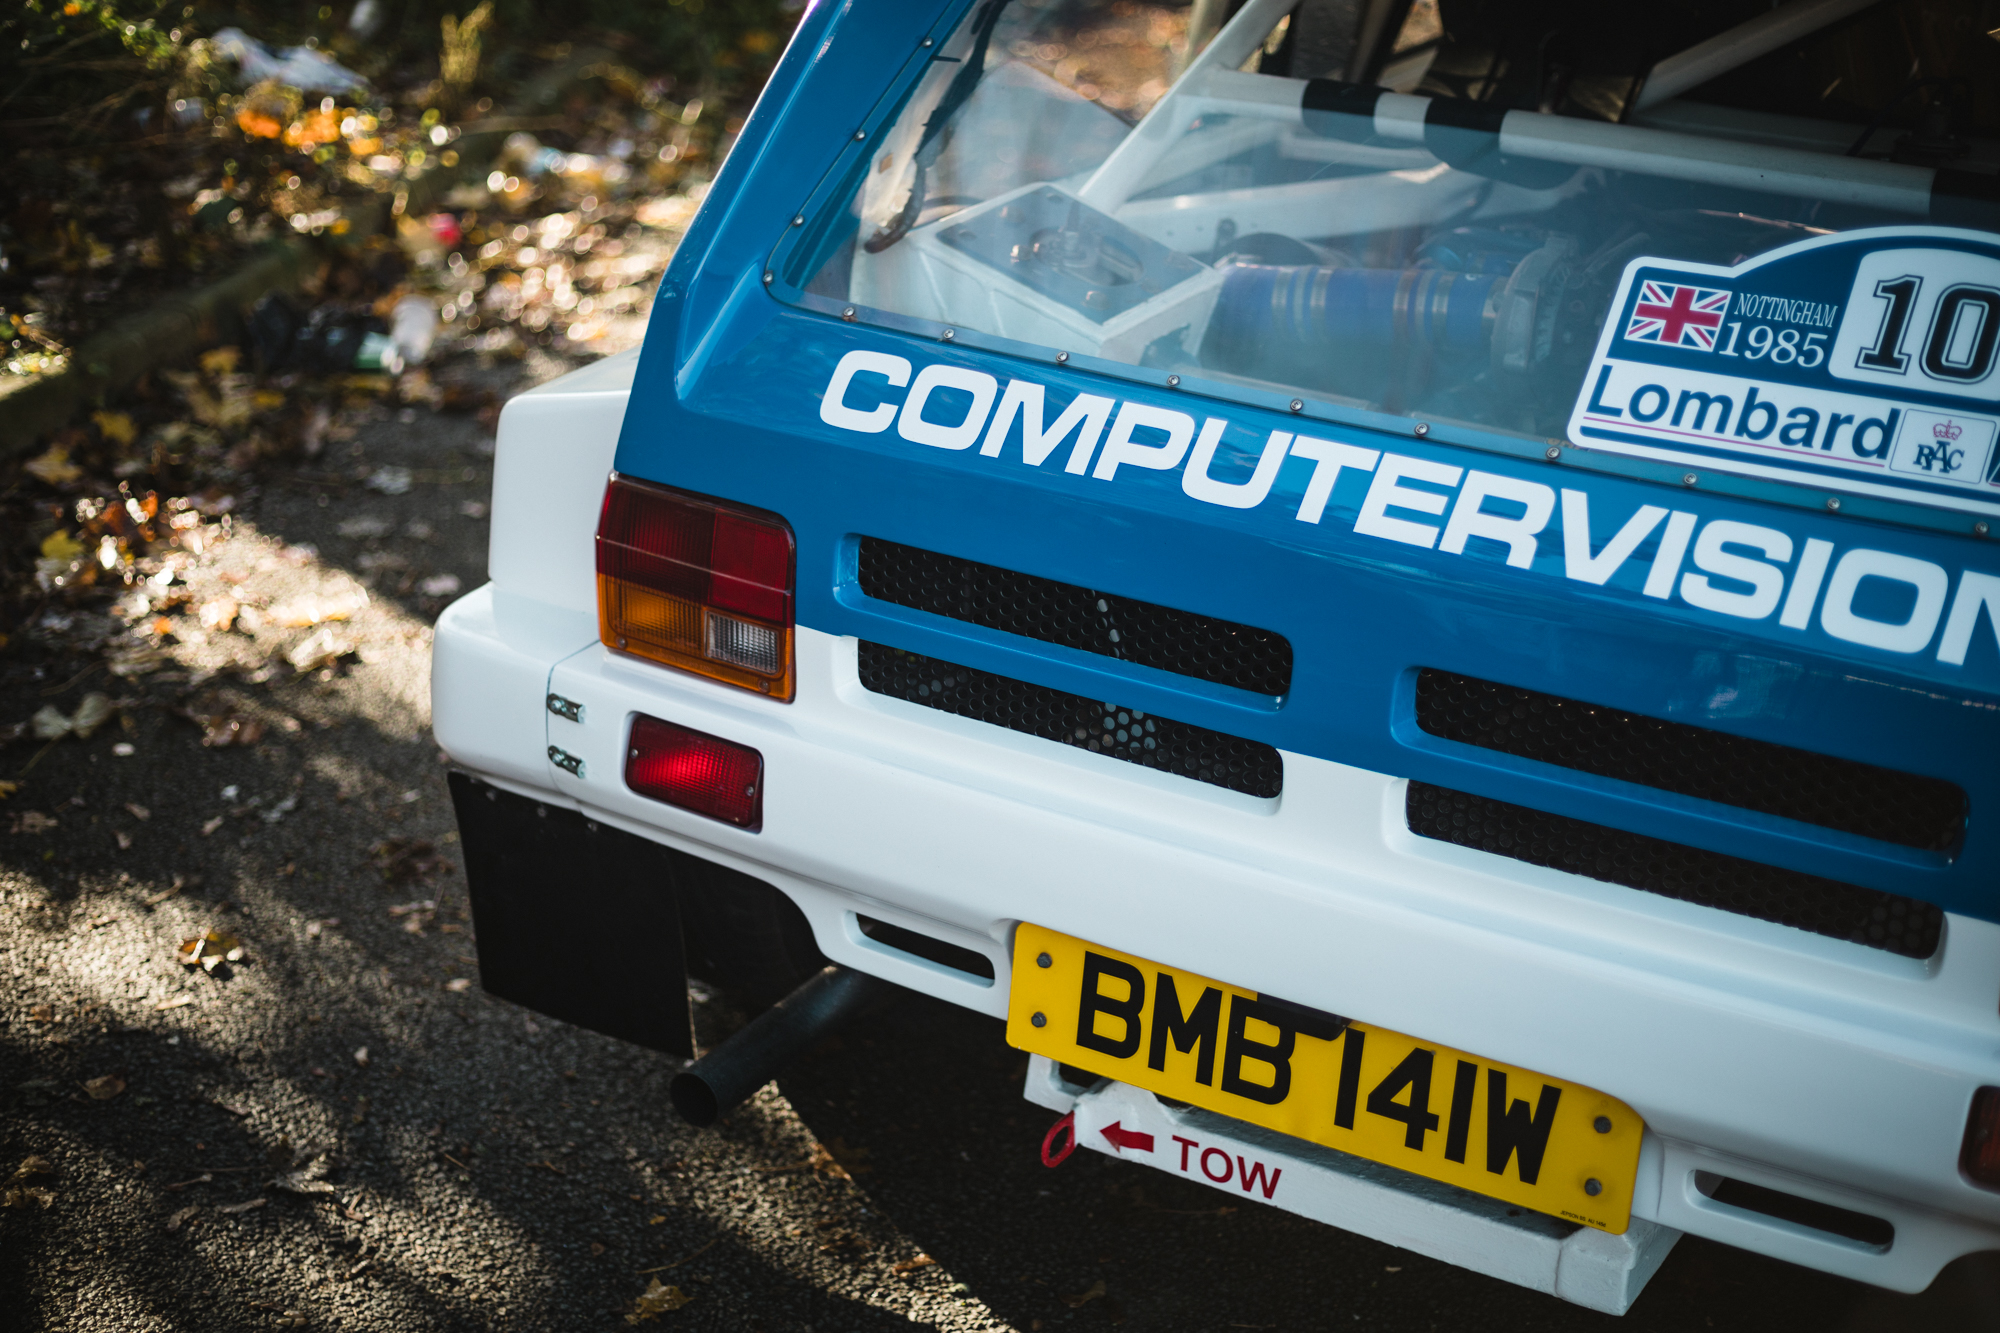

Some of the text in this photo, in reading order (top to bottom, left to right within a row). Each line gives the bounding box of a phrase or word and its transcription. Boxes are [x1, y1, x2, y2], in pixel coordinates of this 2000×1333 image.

[1734, 292, 1838, 328] NOTTINGHAM
[1854, 273, 2000, 385] 10
[1718, 321, 1829, 368] 1985
[1586, 364, 1902, 461] Lombard
[1912, 440, 1965, 474] RAC
[1075, 950, 1562, 1186] BMB 141W
[1171, 1134, 1282, 1200] TOW
